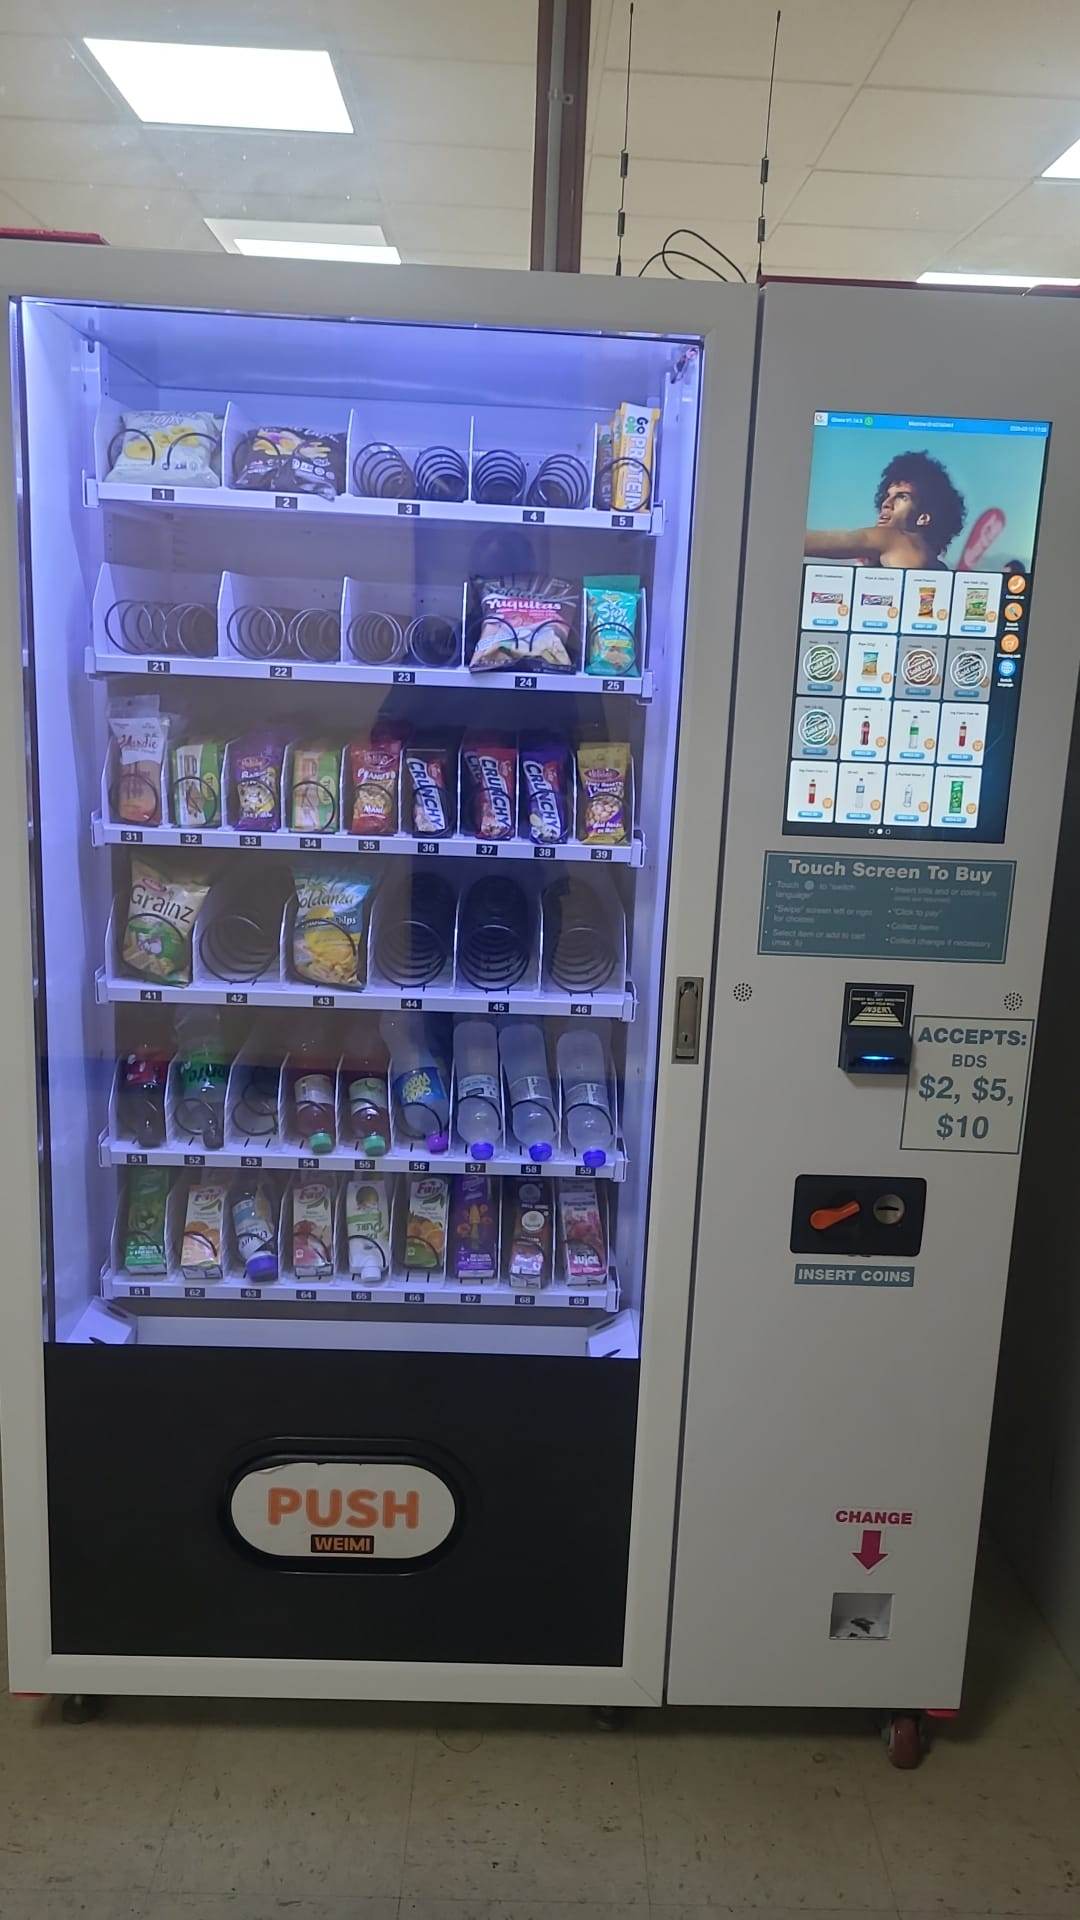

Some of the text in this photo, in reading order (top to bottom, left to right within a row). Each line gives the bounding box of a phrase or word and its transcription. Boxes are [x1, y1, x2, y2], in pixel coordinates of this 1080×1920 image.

[160, 490, 166, 500] 1
[283, 498, 289, 507] 2
[406, 505, 412, 515] 3
[531, 512, 537, 521] 4
[620, 517, 626, 525] 5
[153, 663, 165, 672] 21
[275, 668, 287, 677] 22
[398, 673, 410, 681] 23
[520, 678, 532, 686] 24
[607, 681, 619, 690] 25
[126, 832, 138, 841] 31
[185, 834, 197, 843] 32
[245, 837, 256, 845] 33
[305, 839, 317, 848] 34
[364, 841, 375, 849] 35
[423, 844, 434, 852] 36
[481, 846, 493, 855] 37
[539, 848, 551, 857] 38
[599, 850, 611, 859] 39
[789, 859, 992, 885] Touch Screen To Buy
[131, 884, 194, 924] Grainz
[145, 991, 157, 1000] 41
[231, 994, 244, 1003] 42
[317, 997, 330, 1006] 43
[405, 999, 418, 1008] 44
[492, 1003, 505, 1012] 45
[575, 1005, 587, 1014] 46
[918, 1026, 1026, 1047] ACCEPTS:
[951, 1053, 987, 1068] BDS
[918, 1073, 1014, 1106] $2, $5,
[936, 1112, 989, 1140] $10
[131, 1154, 143, 1163] 51
[188, 1156, 201, 1164] 52
[245, 1157, 258, 1166] 53
[303, 1159, 315, 1168] 54
[359, 1160, 371, 1169] 55
[413, 1162, 425, 1171] 56
[469, 1163, 481, 1172] 57
[525, 1165, 537, 1174] 58
[580, 1166, 592, 1175] 59
[798, 1268, 911, 1283] INSERT COINS
[134, 1287, 146, 1296] 61
[189, 1288, 201, 1297] 62
[245, 1289, 257, 1298] 63
[300, 1290, 312, 1299] 64
[355, 1292, 368, 1300] 65
[408, 1293, 421, 1302] 66
[465, 1294, 477, 1302] 67
[519, 1296, 531, 1305] 68
[573, 1297, 585, 1306] 69
[268, 1487, 419, 1529] PUSH
[835, 1510, 913, 1525] CHANGE
[314, 1537, 371, 1553] WEIMI
